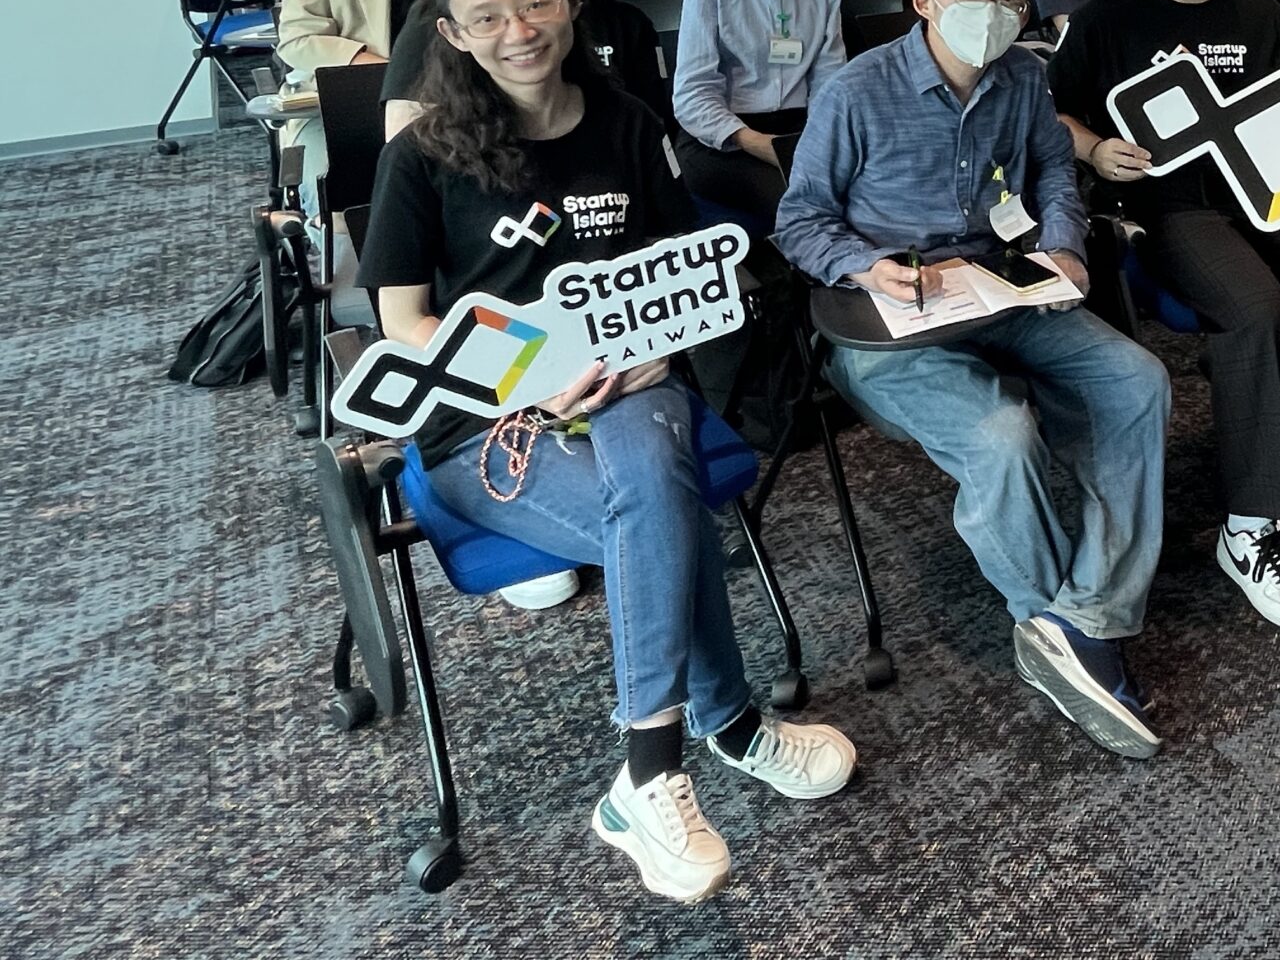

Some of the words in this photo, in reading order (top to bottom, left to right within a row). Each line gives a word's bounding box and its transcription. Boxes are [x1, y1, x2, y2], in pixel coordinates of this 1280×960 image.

[1198, 43, 1247, 55] Startup
[1204, 54, 1243, 66] Island
[563, 192, 630, 213] Startup
[573, 207, 626, 230] Island
[574, 227, 625, 240] TAIWAN
[558, 235, 739, 309] Startup
[585, 264, 729, 345] Island
[595, 309, 735, 363] TAIWAN
